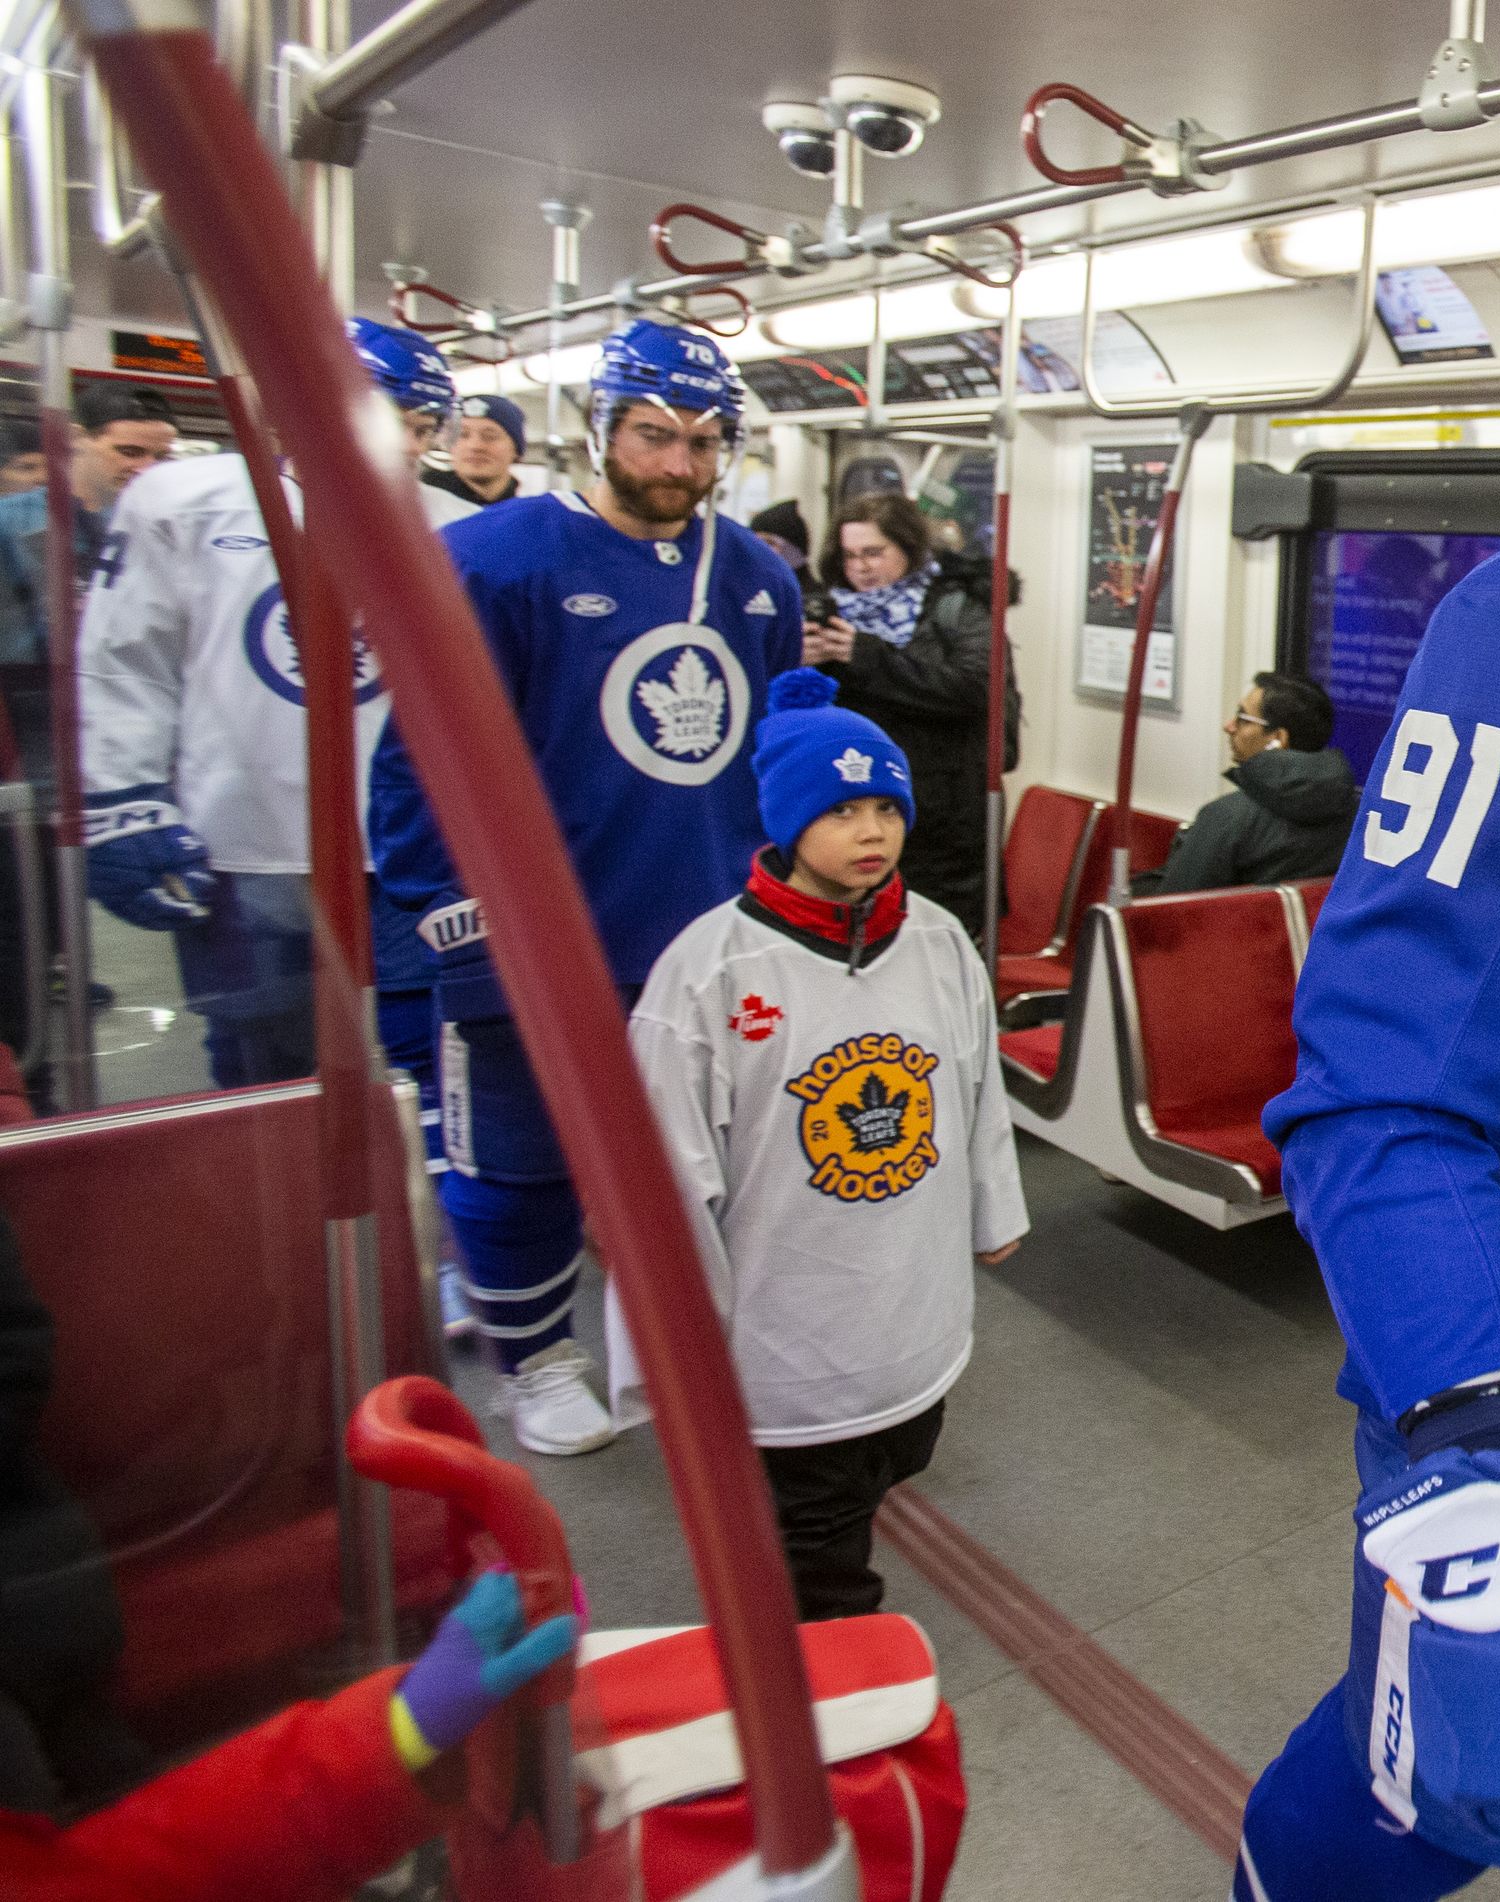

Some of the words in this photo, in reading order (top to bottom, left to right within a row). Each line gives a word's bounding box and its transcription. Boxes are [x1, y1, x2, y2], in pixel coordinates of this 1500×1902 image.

[786, 1033, 903, 1103] house
[902, 1043, 940, 1082] of
[810, 1119, 830, 1141] 20
[808, 1131, 940, 1203] hockey
[1363, 1499, 1404, 1527] MAPLE
[1400, 1474, 1443, 1506] LEAFS
[1382, 1682, 1405, 1783] CCM
